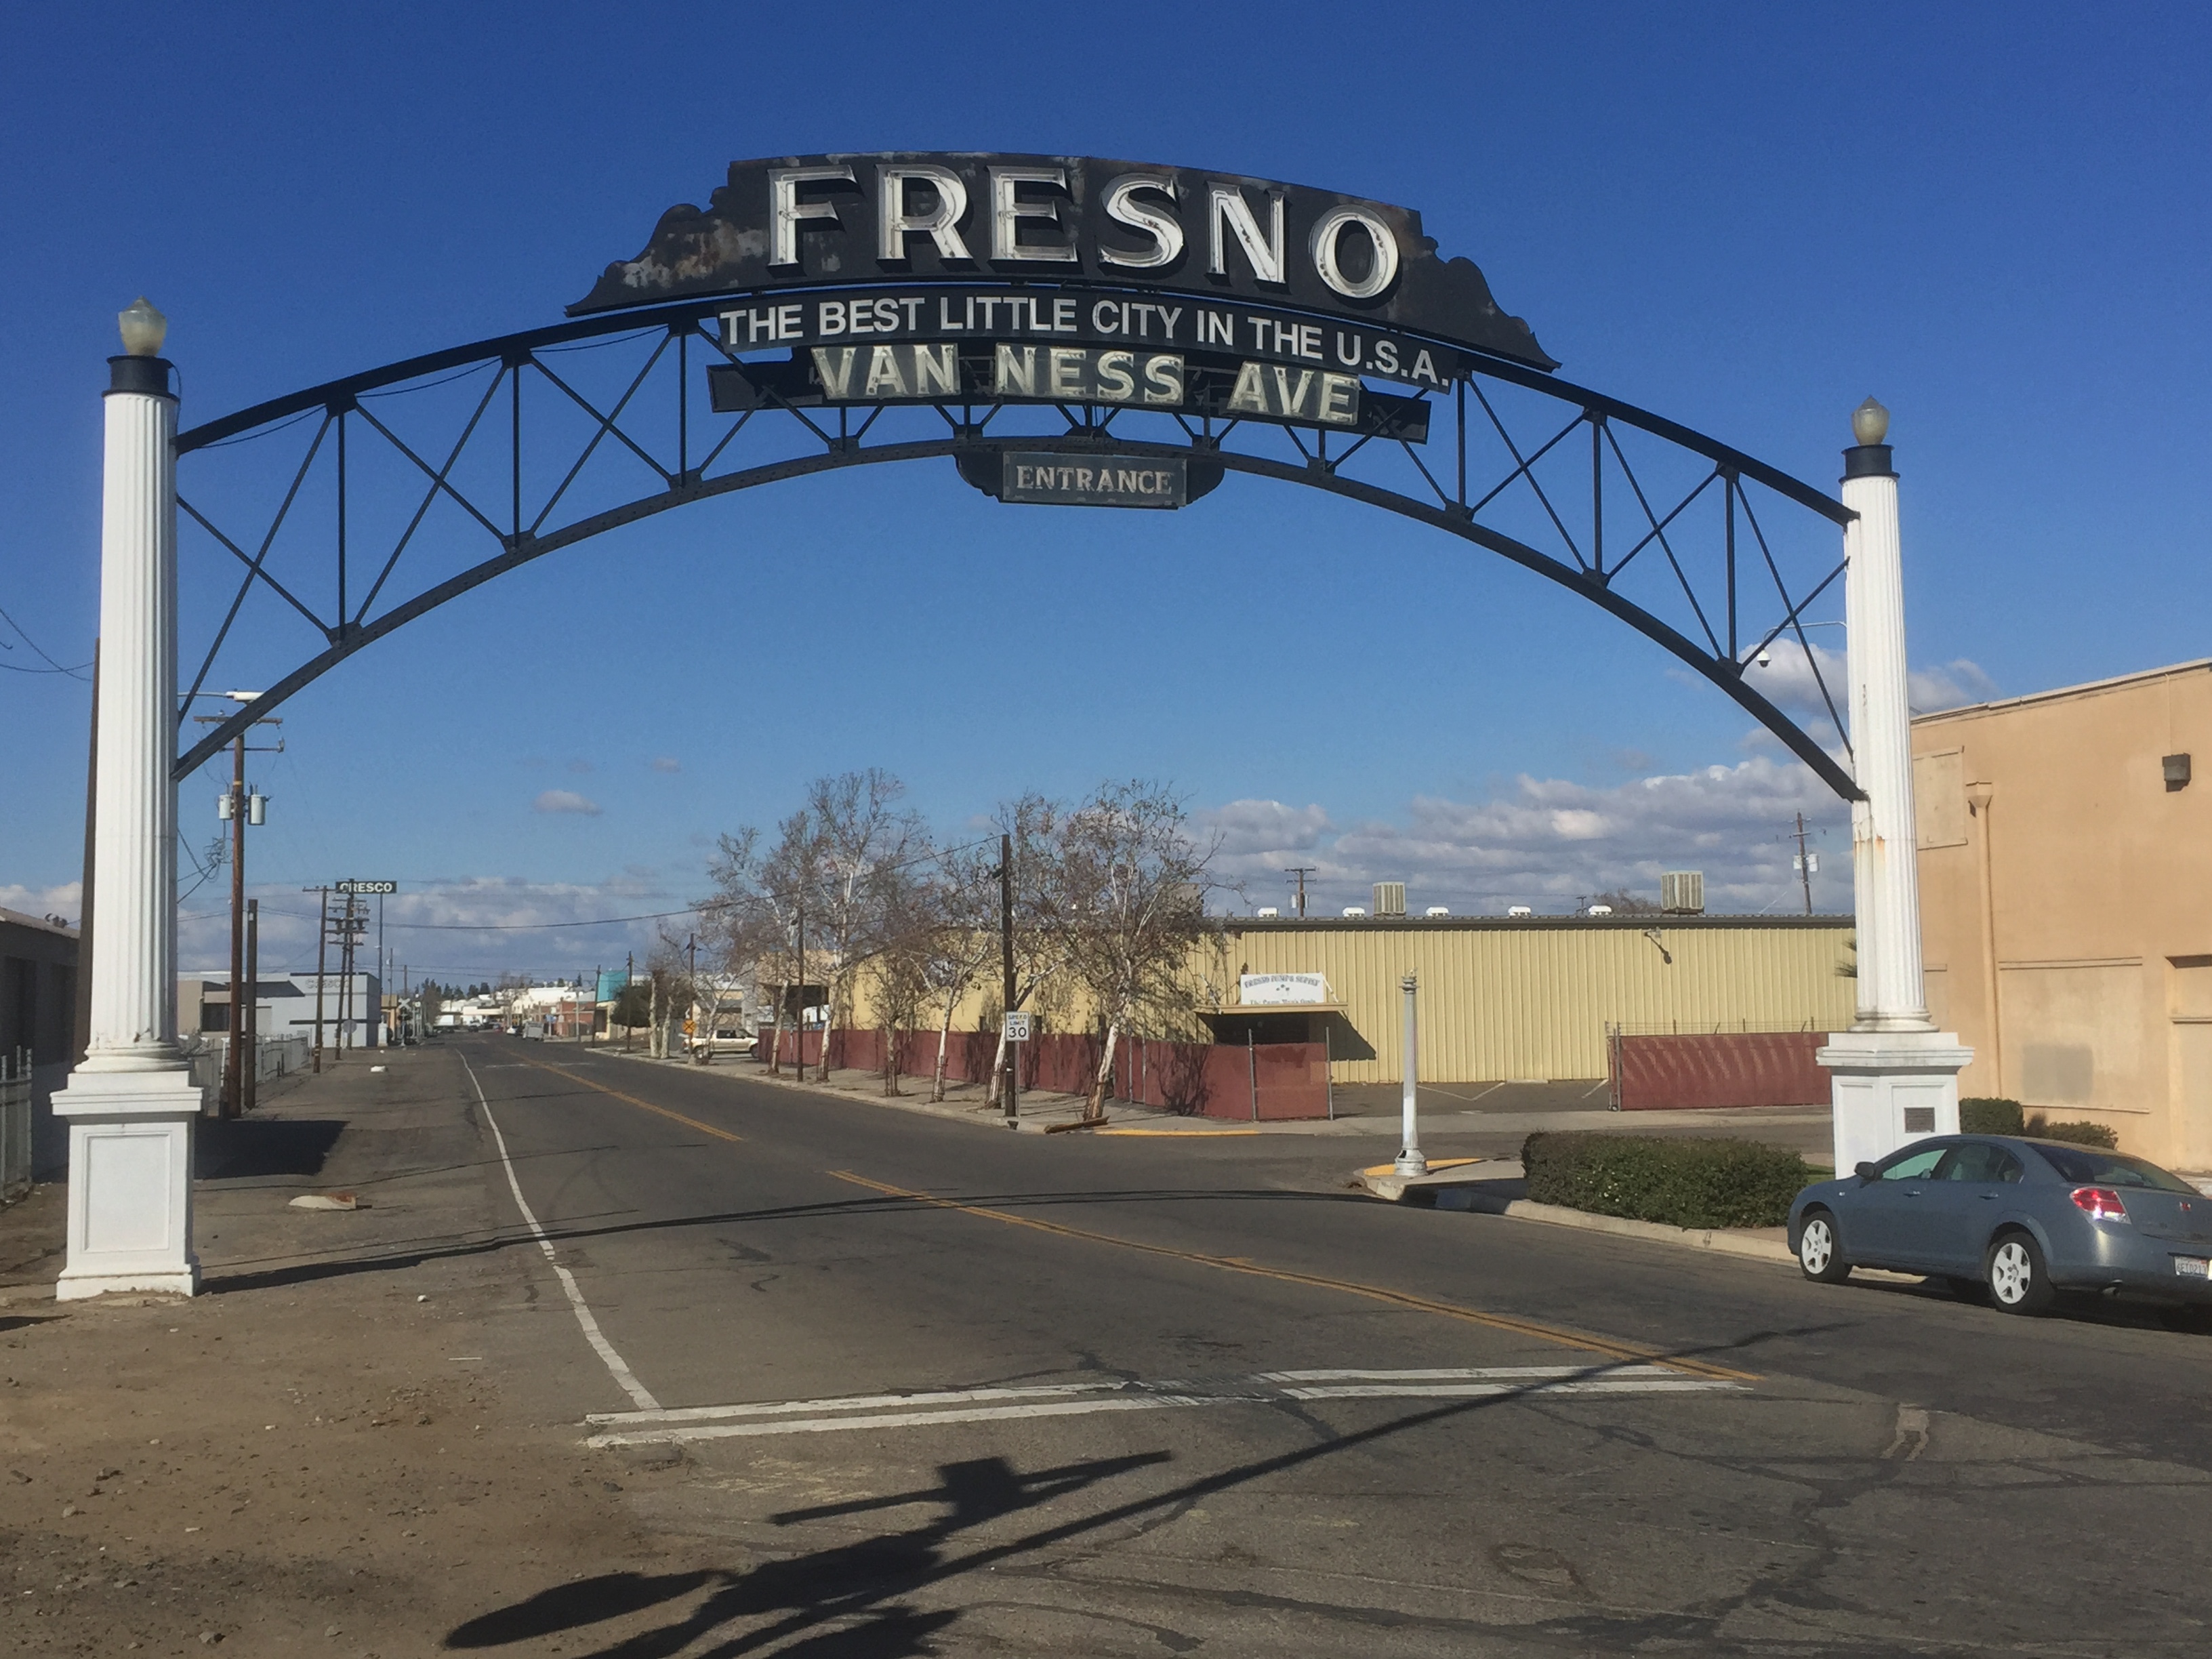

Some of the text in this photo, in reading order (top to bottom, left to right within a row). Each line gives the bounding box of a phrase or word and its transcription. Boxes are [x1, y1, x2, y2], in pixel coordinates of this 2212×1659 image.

[767, 163, 1400, 299] FRESNO
[719, 296, 1450, 386] THE BEST LITTLE CITY IN THE U.S.A.
[811, 344, 1357, 424] VAN NESS AVE
[1016, 464, 1174, 495] ENTRANCE
[1008, 1026, 1027, 1038] 30
